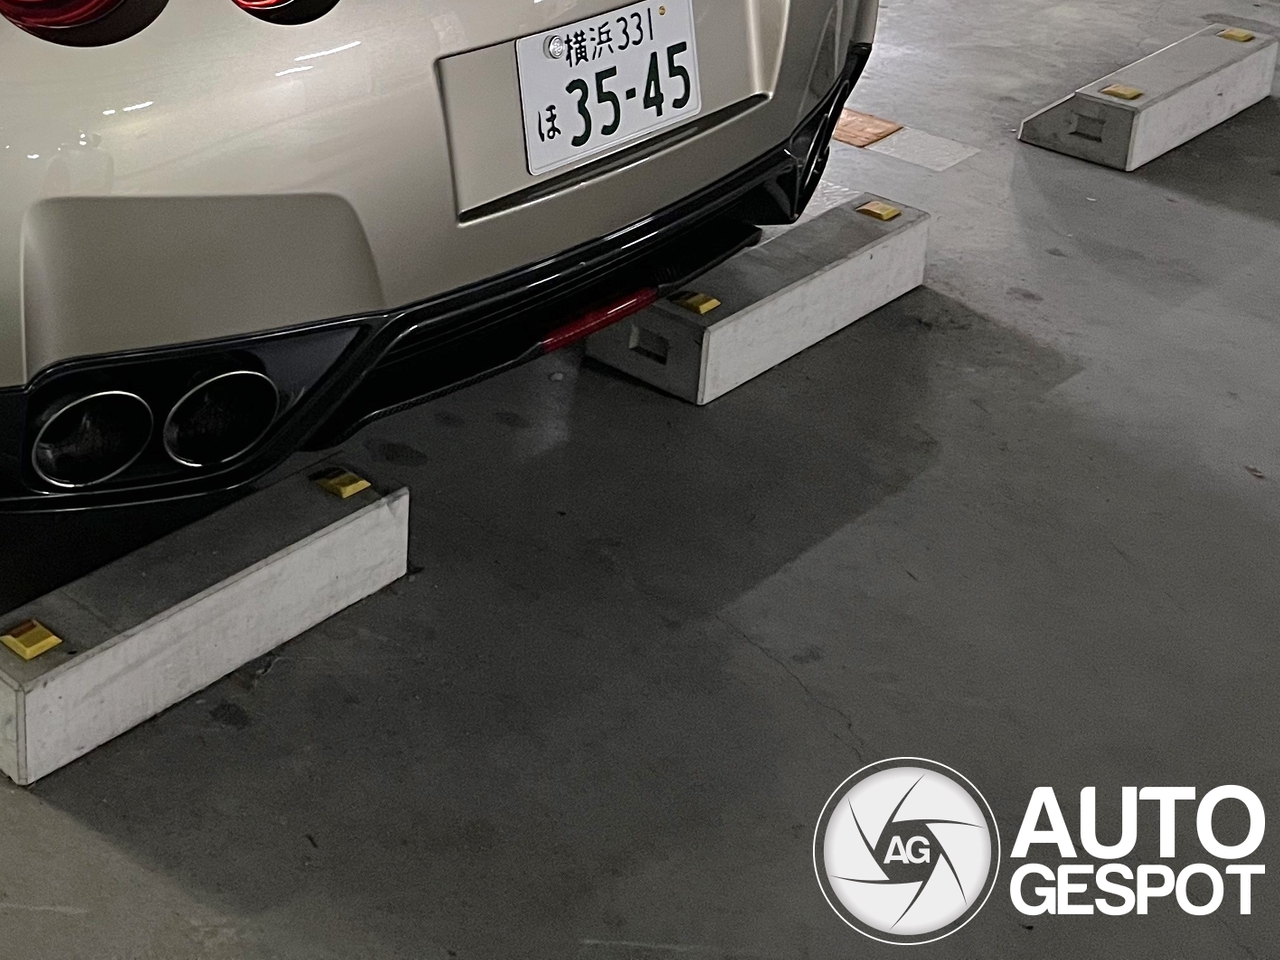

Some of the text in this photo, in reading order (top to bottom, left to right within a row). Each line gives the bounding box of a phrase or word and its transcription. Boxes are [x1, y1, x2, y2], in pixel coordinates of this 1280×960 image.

[564, 7, 654, 68] 横浜 331
[537, 41, 691, 148] ほ 35-45
